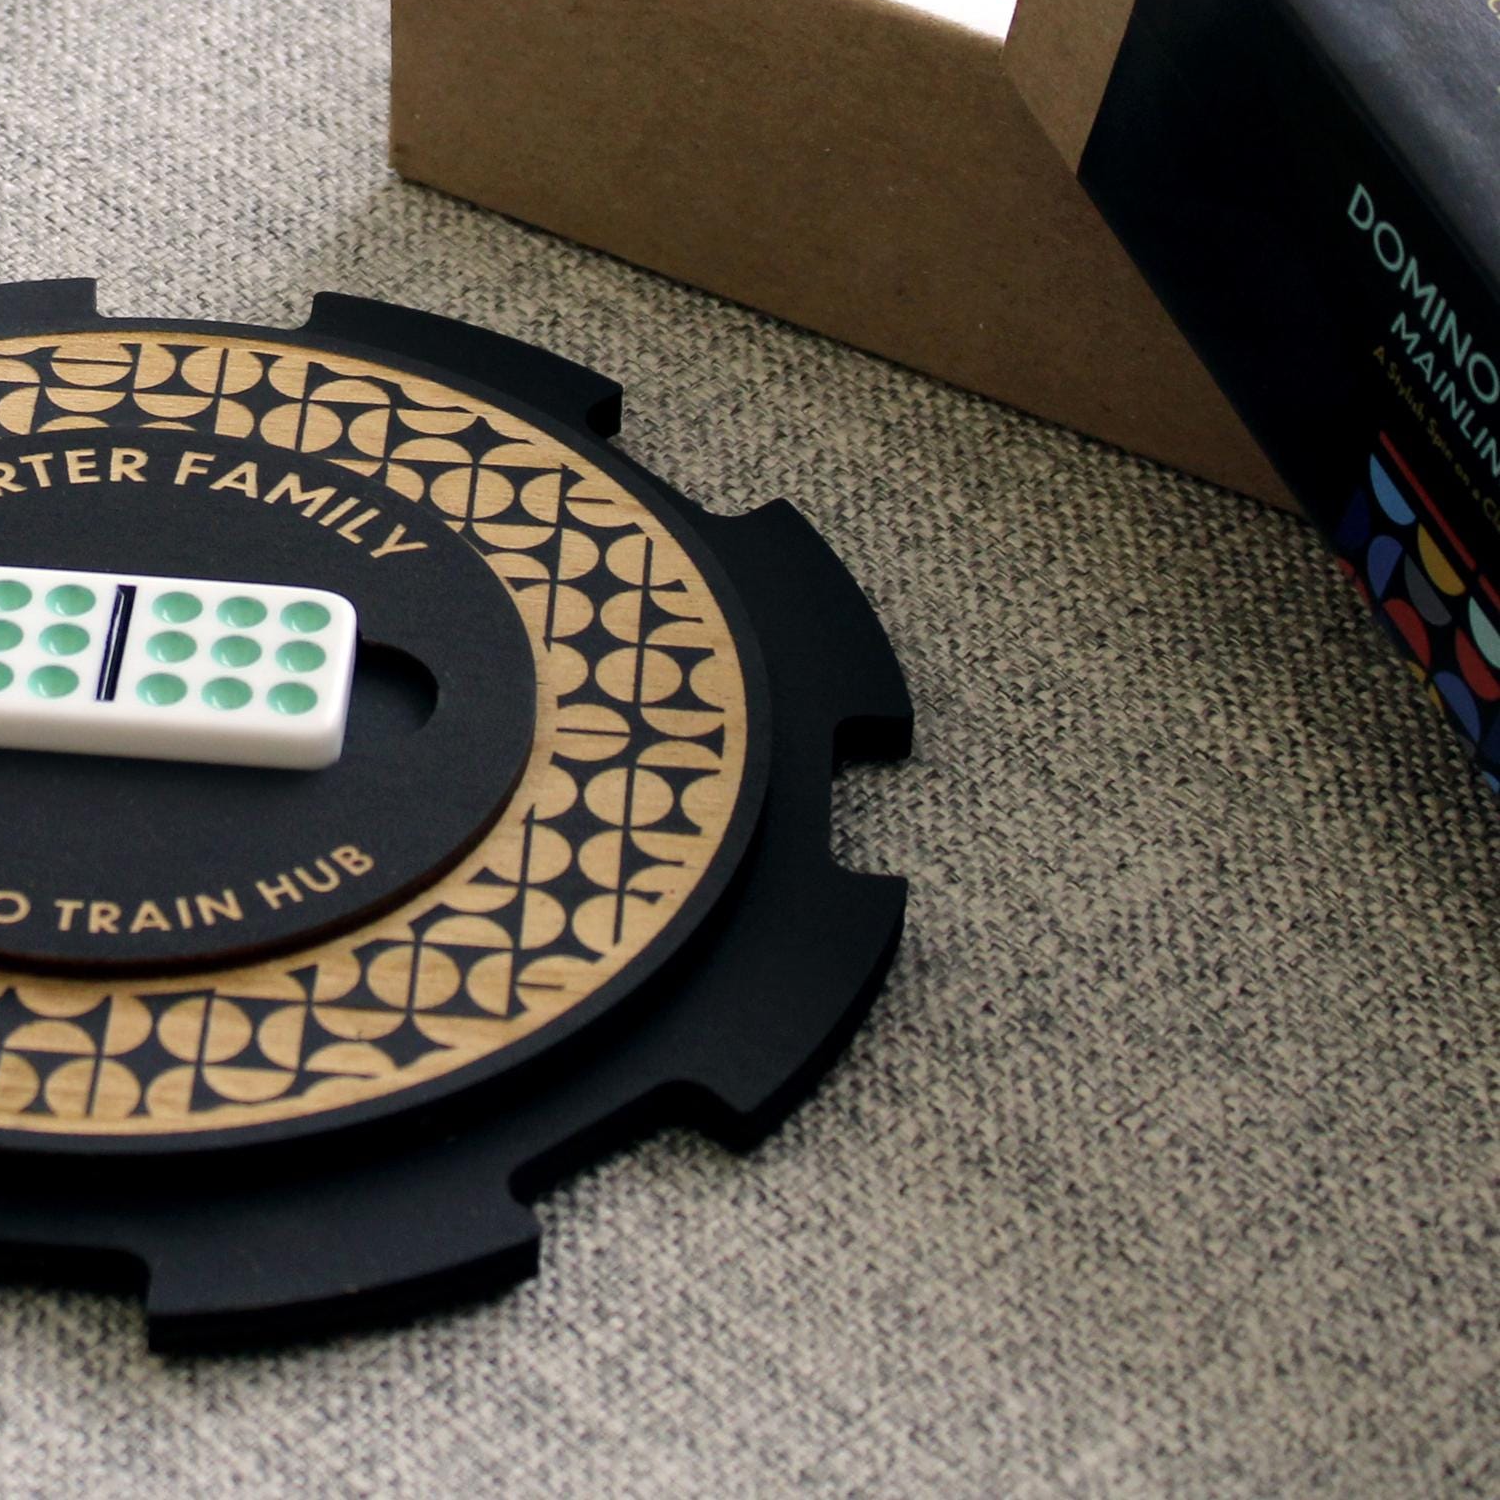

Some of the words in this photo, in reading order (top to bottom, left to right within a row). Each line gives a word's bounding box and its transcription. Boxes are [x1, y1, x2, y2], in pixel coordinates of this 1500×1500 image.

[1348, 183, 1500, 406] DOMINO
[1373, 345, 1385, 366] A
[174, 451, 429, 560] FAMILY
[54, 889, 243, 936] TRAIN
[255, 845, 375, 908] HUB
